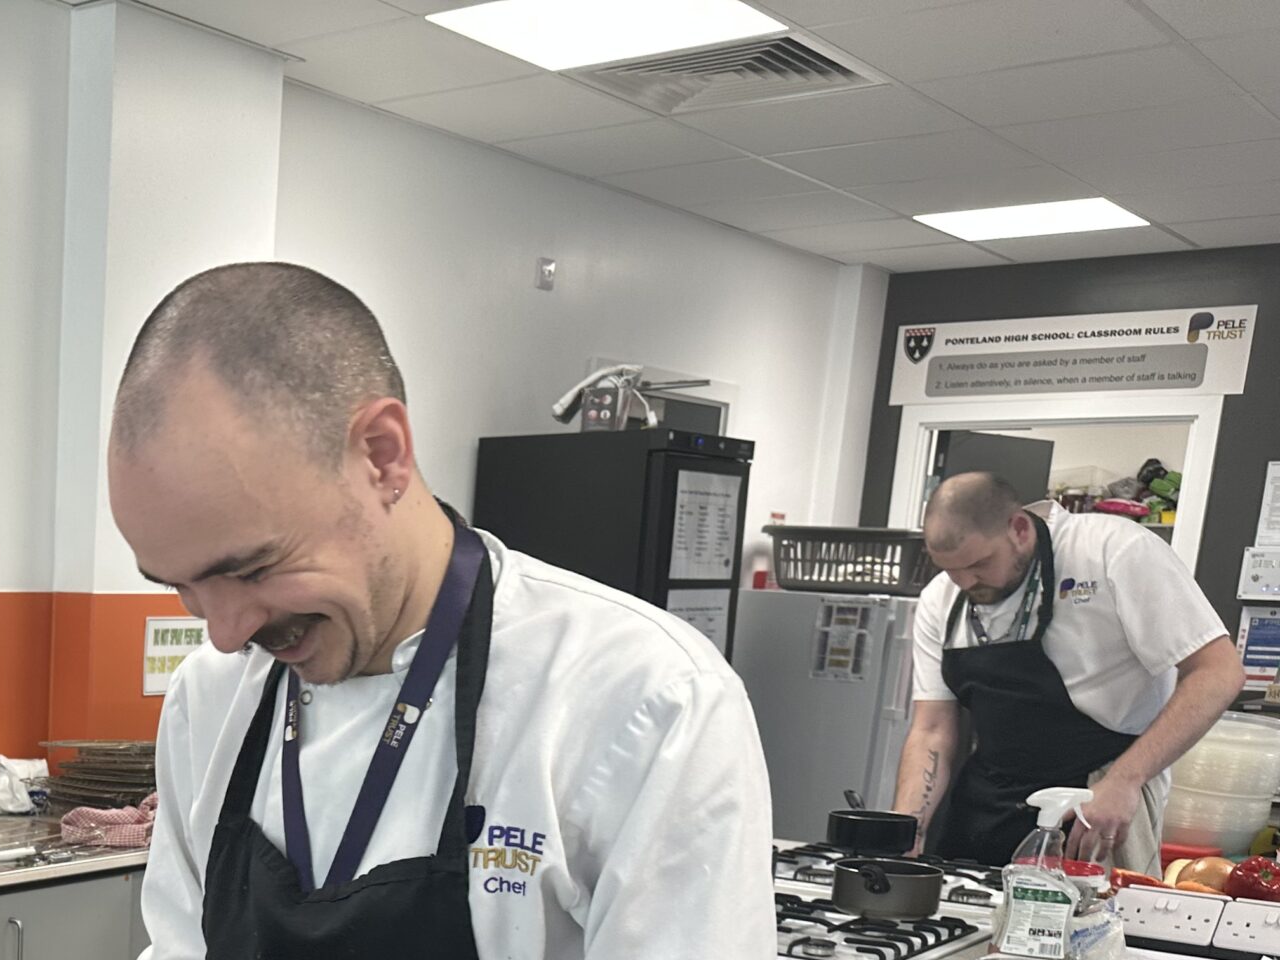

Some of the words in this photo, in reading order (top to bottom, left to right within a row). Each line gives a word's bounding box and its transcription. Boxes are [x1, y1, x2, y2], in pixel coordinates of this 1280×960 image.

[1217, 319, 1247, 330] PELE
[945, 335, 1001, 346] PONTELAND
[1004, 333, 1029, 343] HIGH
[1031, 331, 1074, 341] SCHOOL:
[1077, 327, 1142, 339] CLASSROOM
[1145, 326, 1180, 336] RULES
[1206, 330, 1245, 340] TRUST
[1000, 362, 1015, 371] you
[1033, 358, 1057, 367] asked
[1059, 358, 1069, 368] by
[1079, 356, 1114, 365] member
[1116, 355, 1125, 363] of
[1127, 354, 1146, 363] staff
[1057, 376, 1078, 384] when
[1088, 374, 1123, 383] member
[1126, 373, 1136, 382] of
[1137, 372, 1155, 381] staff
[1167, 371, 1197, 382] talking
[383, 714, 401, 744] TRUST
[390, 724, 406, 748] PELE
[488, 826, 546, 855] PELE
[472, 848, 541, 876] TRUST
[484, 877, 526, 896] Chef
